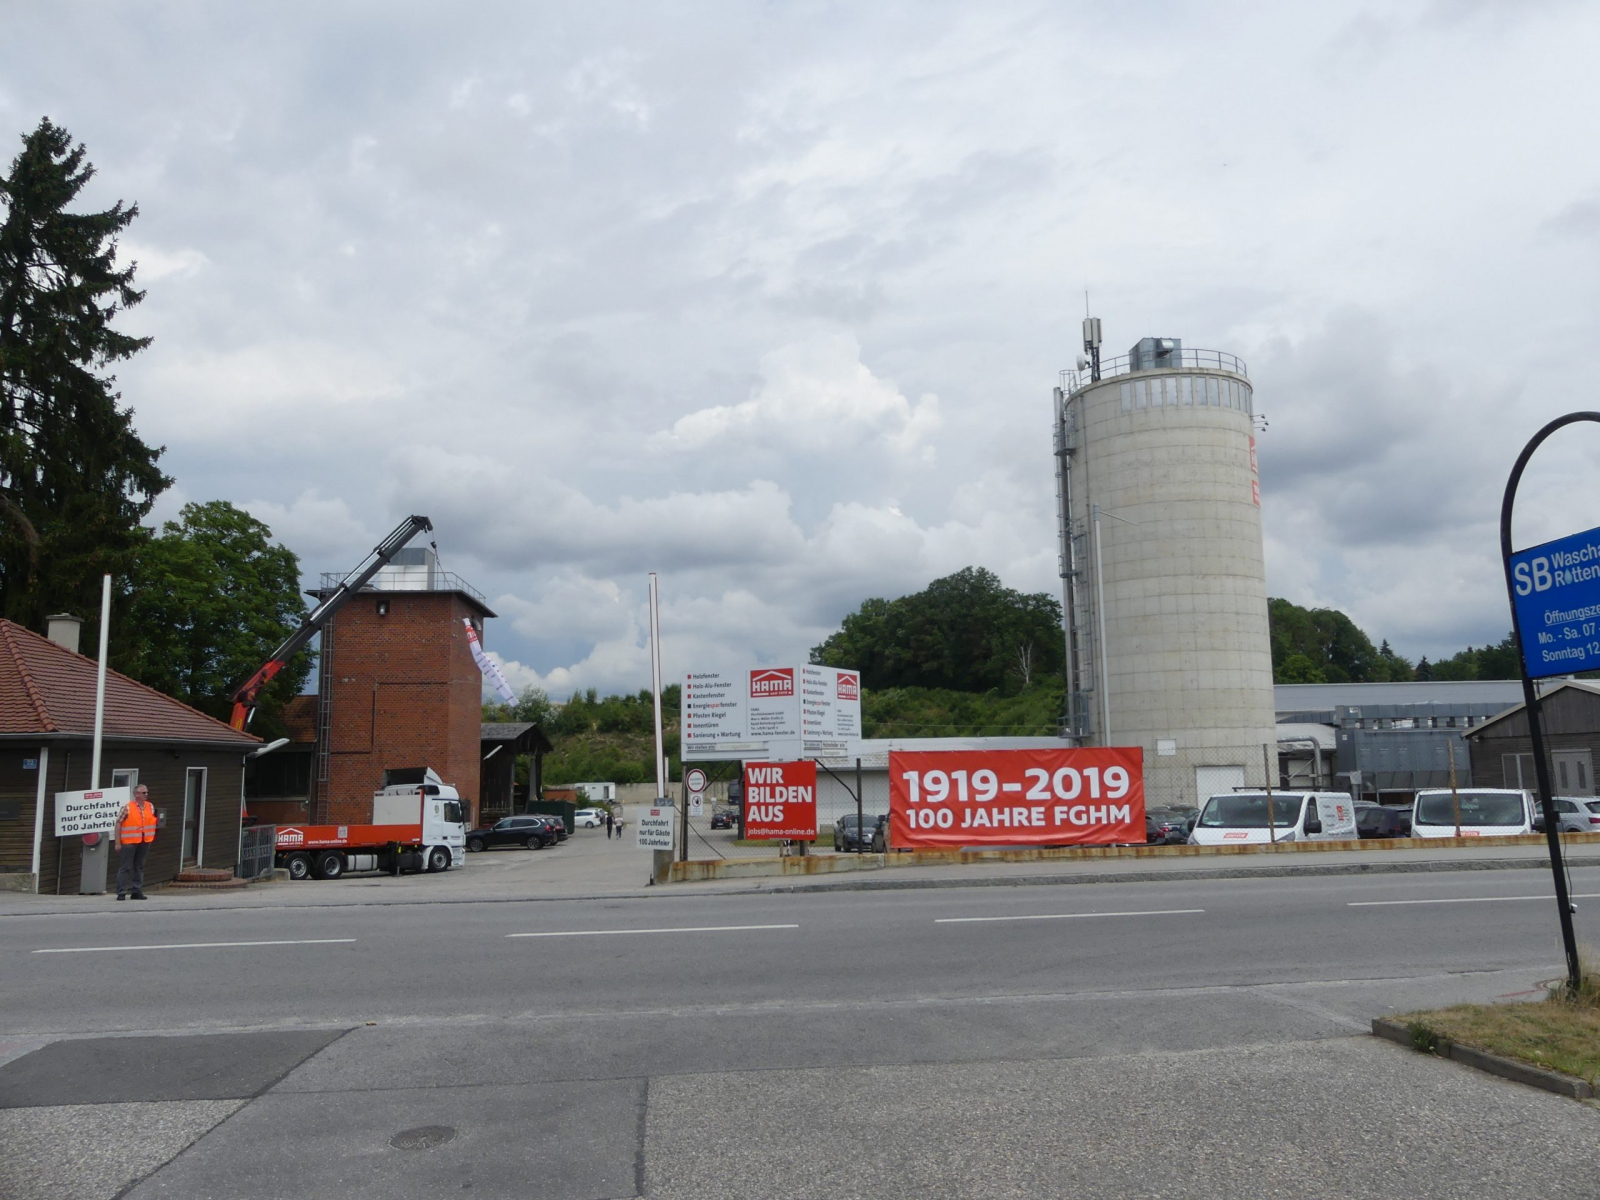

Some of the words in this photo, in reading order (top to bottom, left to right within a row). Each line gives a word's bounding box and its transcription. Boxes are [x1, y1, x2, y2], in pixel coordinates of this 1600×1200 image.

[1514, 556, 1553, 596] SB
[1555, 564, 1600, 587] Rotten
[1538, 632, 1556, 644] Mo.
[1563, 627, 1581, 639] Sa.
[1582, 622, 1595, 636] 07
[1542, 647, 1586, 662] Sonntag
[1587, 641, 1600, 655] 12
[752, 680, 792, 692] HAMA
[837, 684, 857, 696] HAMA
[693, 701, 737, 710] Energiesparfenster
[711, 711, 726, 720] Riegel
[693, 721, 719, 729] Innentüren
[720, 731, 741, 739] Wartung
[748, 767, 784, 784] WIR
[902, 766, 1130, 803] 1919-2019
[748, 786, 812, 803] BILDEN
[66, 800, 120, 812] Durchfahrt
[61, 815, 77, 823] nur
[79, 812, 92, 820] für
[94, 810, 118, 819] Gäst
[747, 805, 784, 822] AUS
[906, 808, 953, 829] 100
[961, 806, 1045, 828] JAHRE
[1054, 804, 1130, 826] FGHM
[61, 824, 79, 832] 100
[655, 829, 670, 837] Gäste
[748, 828, 815, 836] jobs@hama-online.de
[278, 834, 303, 843] HAMA
[639, 838, 648, 846] 100
[648, 838, 670, 846] Jahrfeier
